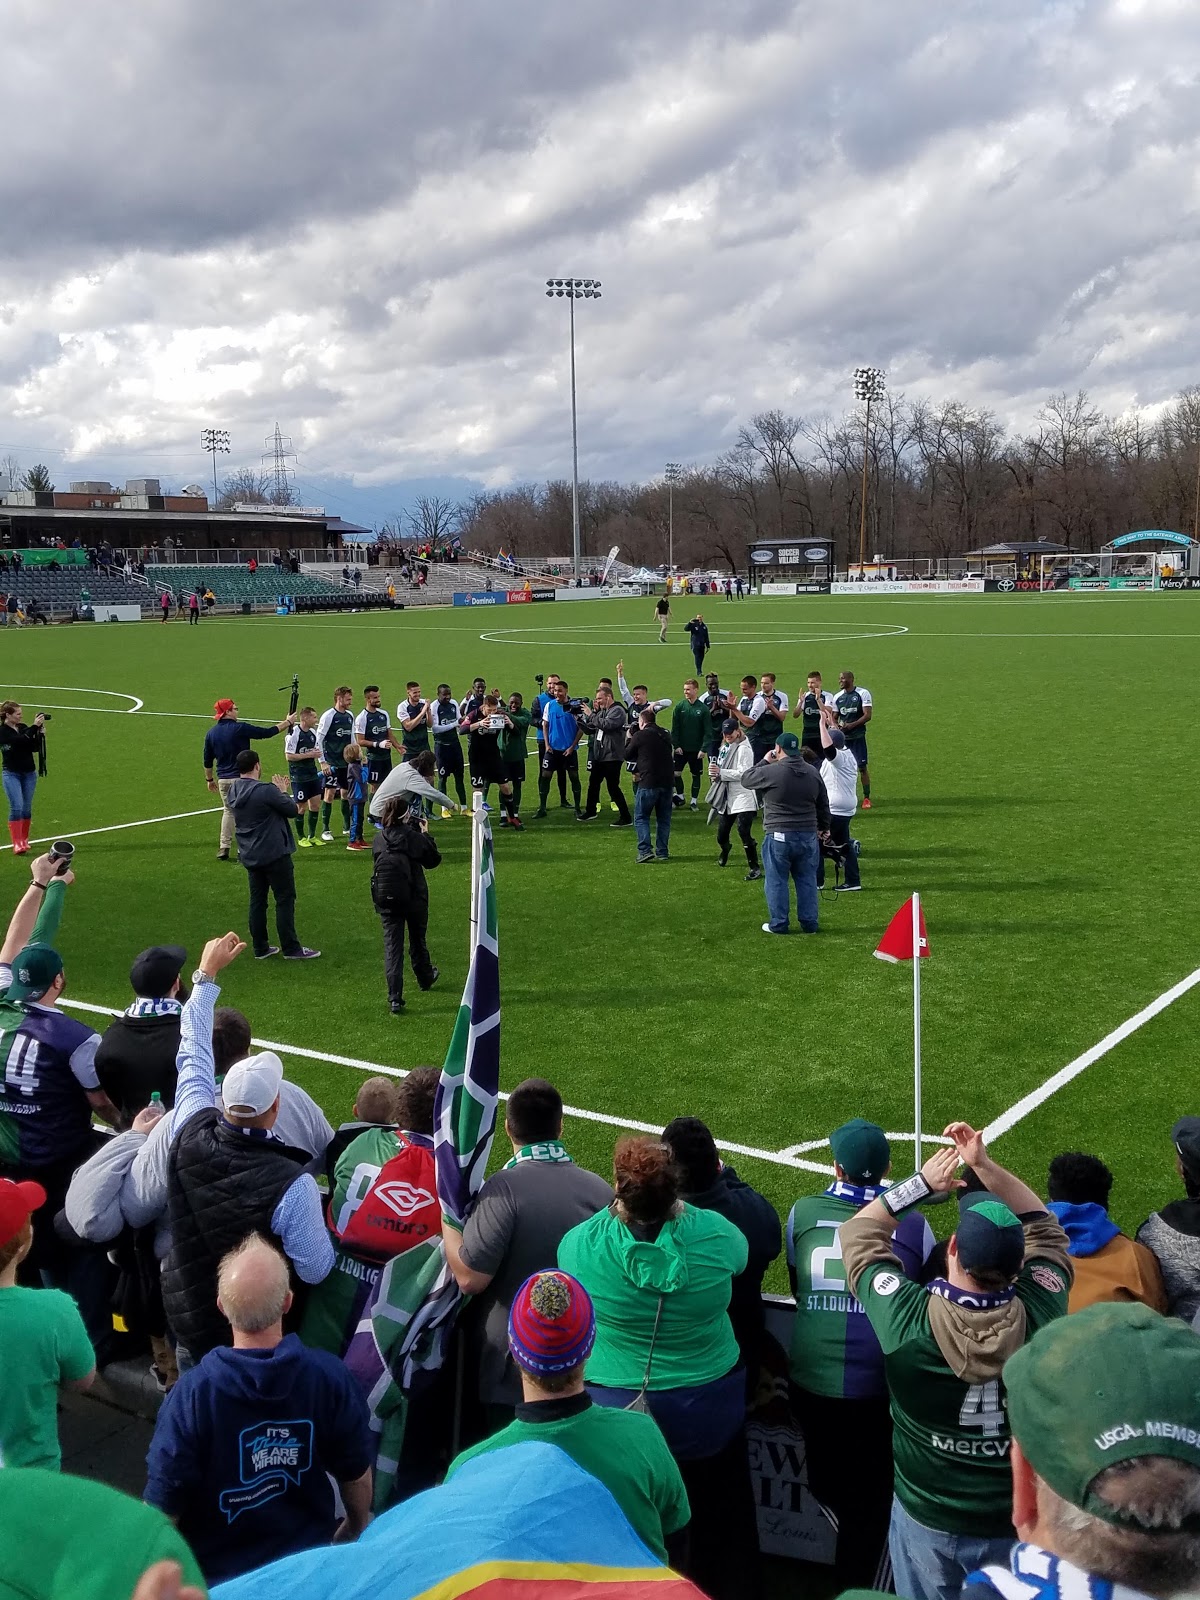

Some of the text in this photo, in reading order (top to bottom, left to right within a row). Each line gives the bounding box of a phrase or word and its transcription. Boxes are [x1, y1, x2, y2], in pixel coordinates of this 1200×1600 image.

[778, 549, 799, 557] SOCCER
[1015, 581, 1055, 589] TOYOTA
[1160, 578, 1183, 588] Mercy
[472, 596, 496, 605] Domino's
[440, 766, 446, 775] 6
[626, 761, 637, 771] 77
[326, 776, 338, 786] 22
[371, 771, 379, 781] 11
[471, 776, 484, 786] 24
[297, 790, 304, 800] 8
[0, 1028, 40, 1096] 4
[367, 1213, 428, 1236] umbro
[806, 1295, 822, 1310] ST.
[959, 1380, 1004, 1436] 4
[266, 1428, 290, 1438] IT'S
[246, 1436, 304, 1453] true
[251, 1447, 299, 1465] WE ARE
[254, 1456, 298, 1473] HIRING
